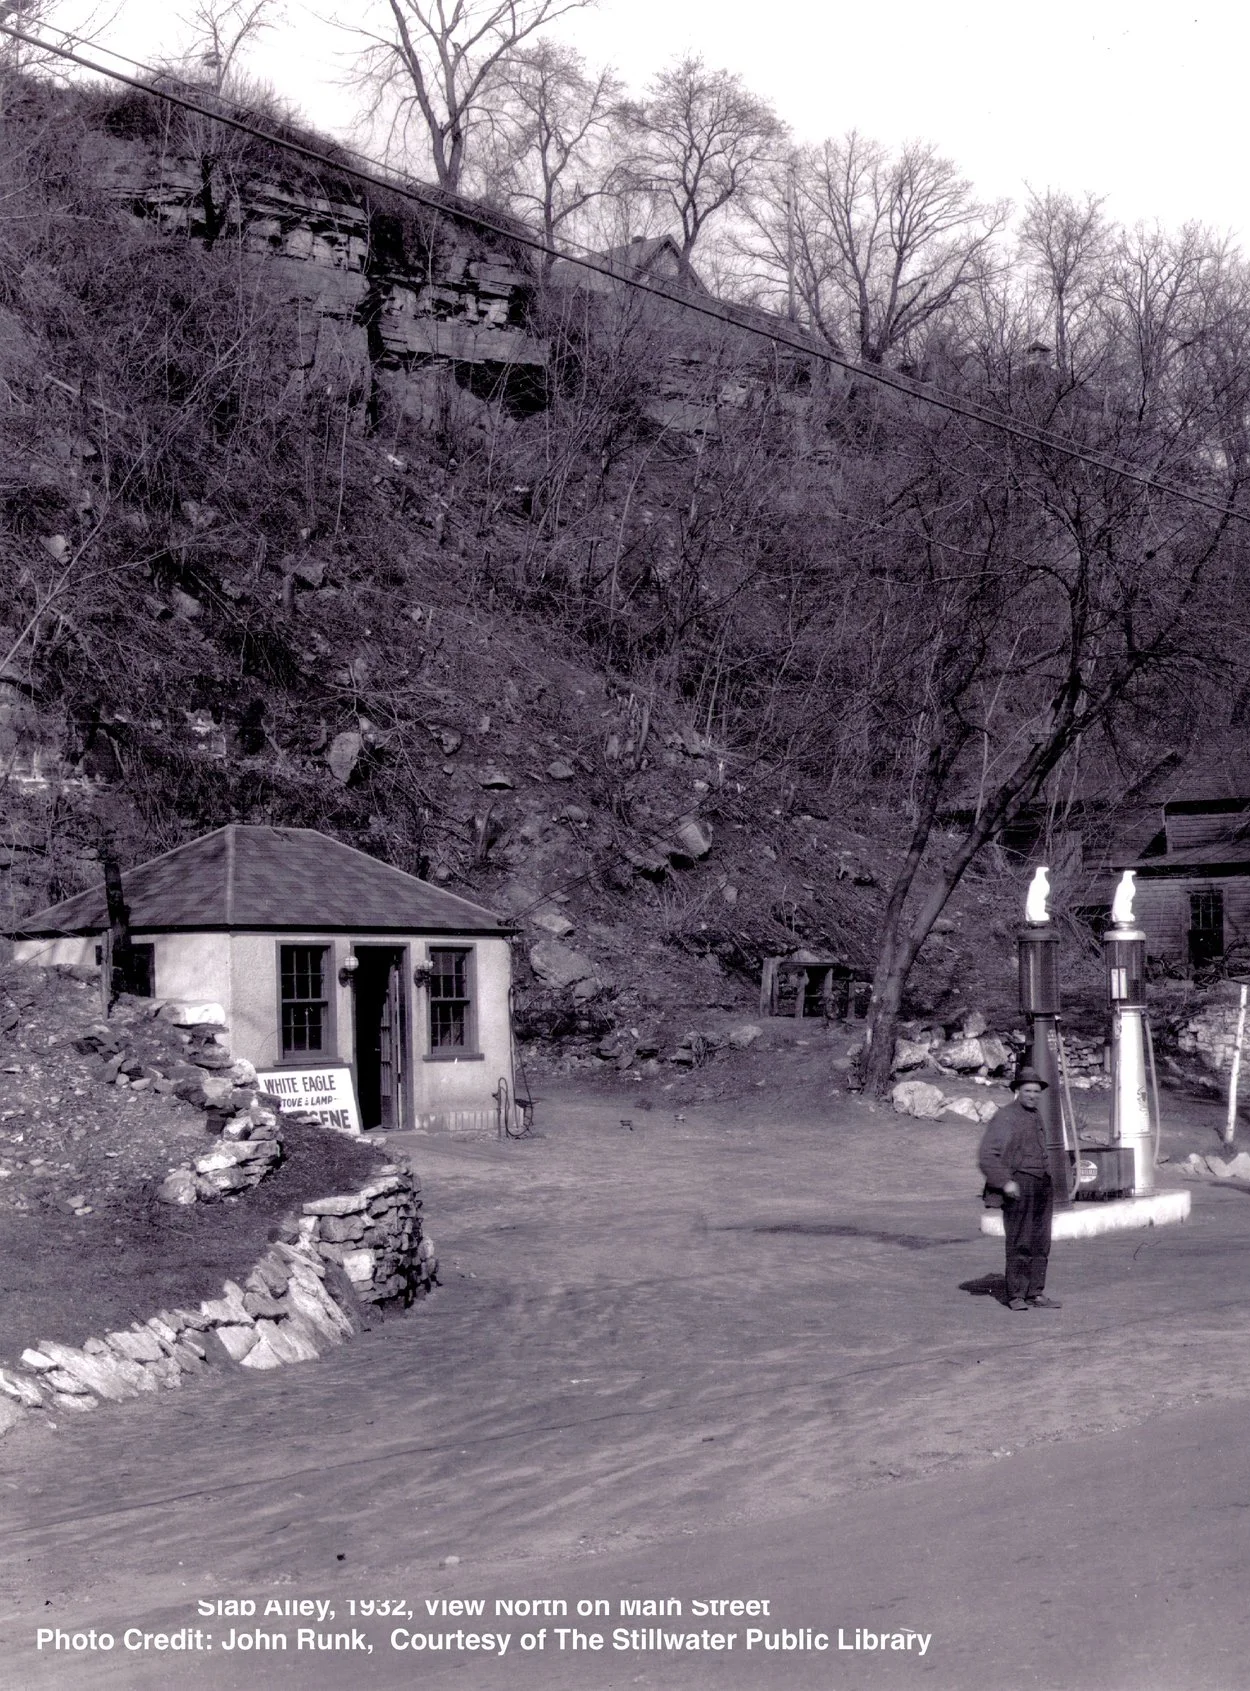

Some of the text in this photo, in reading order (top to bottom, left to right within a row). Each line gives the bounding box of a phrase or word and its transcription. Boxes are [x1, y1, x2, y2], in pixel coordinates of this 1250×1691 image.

[263, 1074, 337, 1095] WHITE EAGLE
[281, 1097, 303, 1108] TOVE
